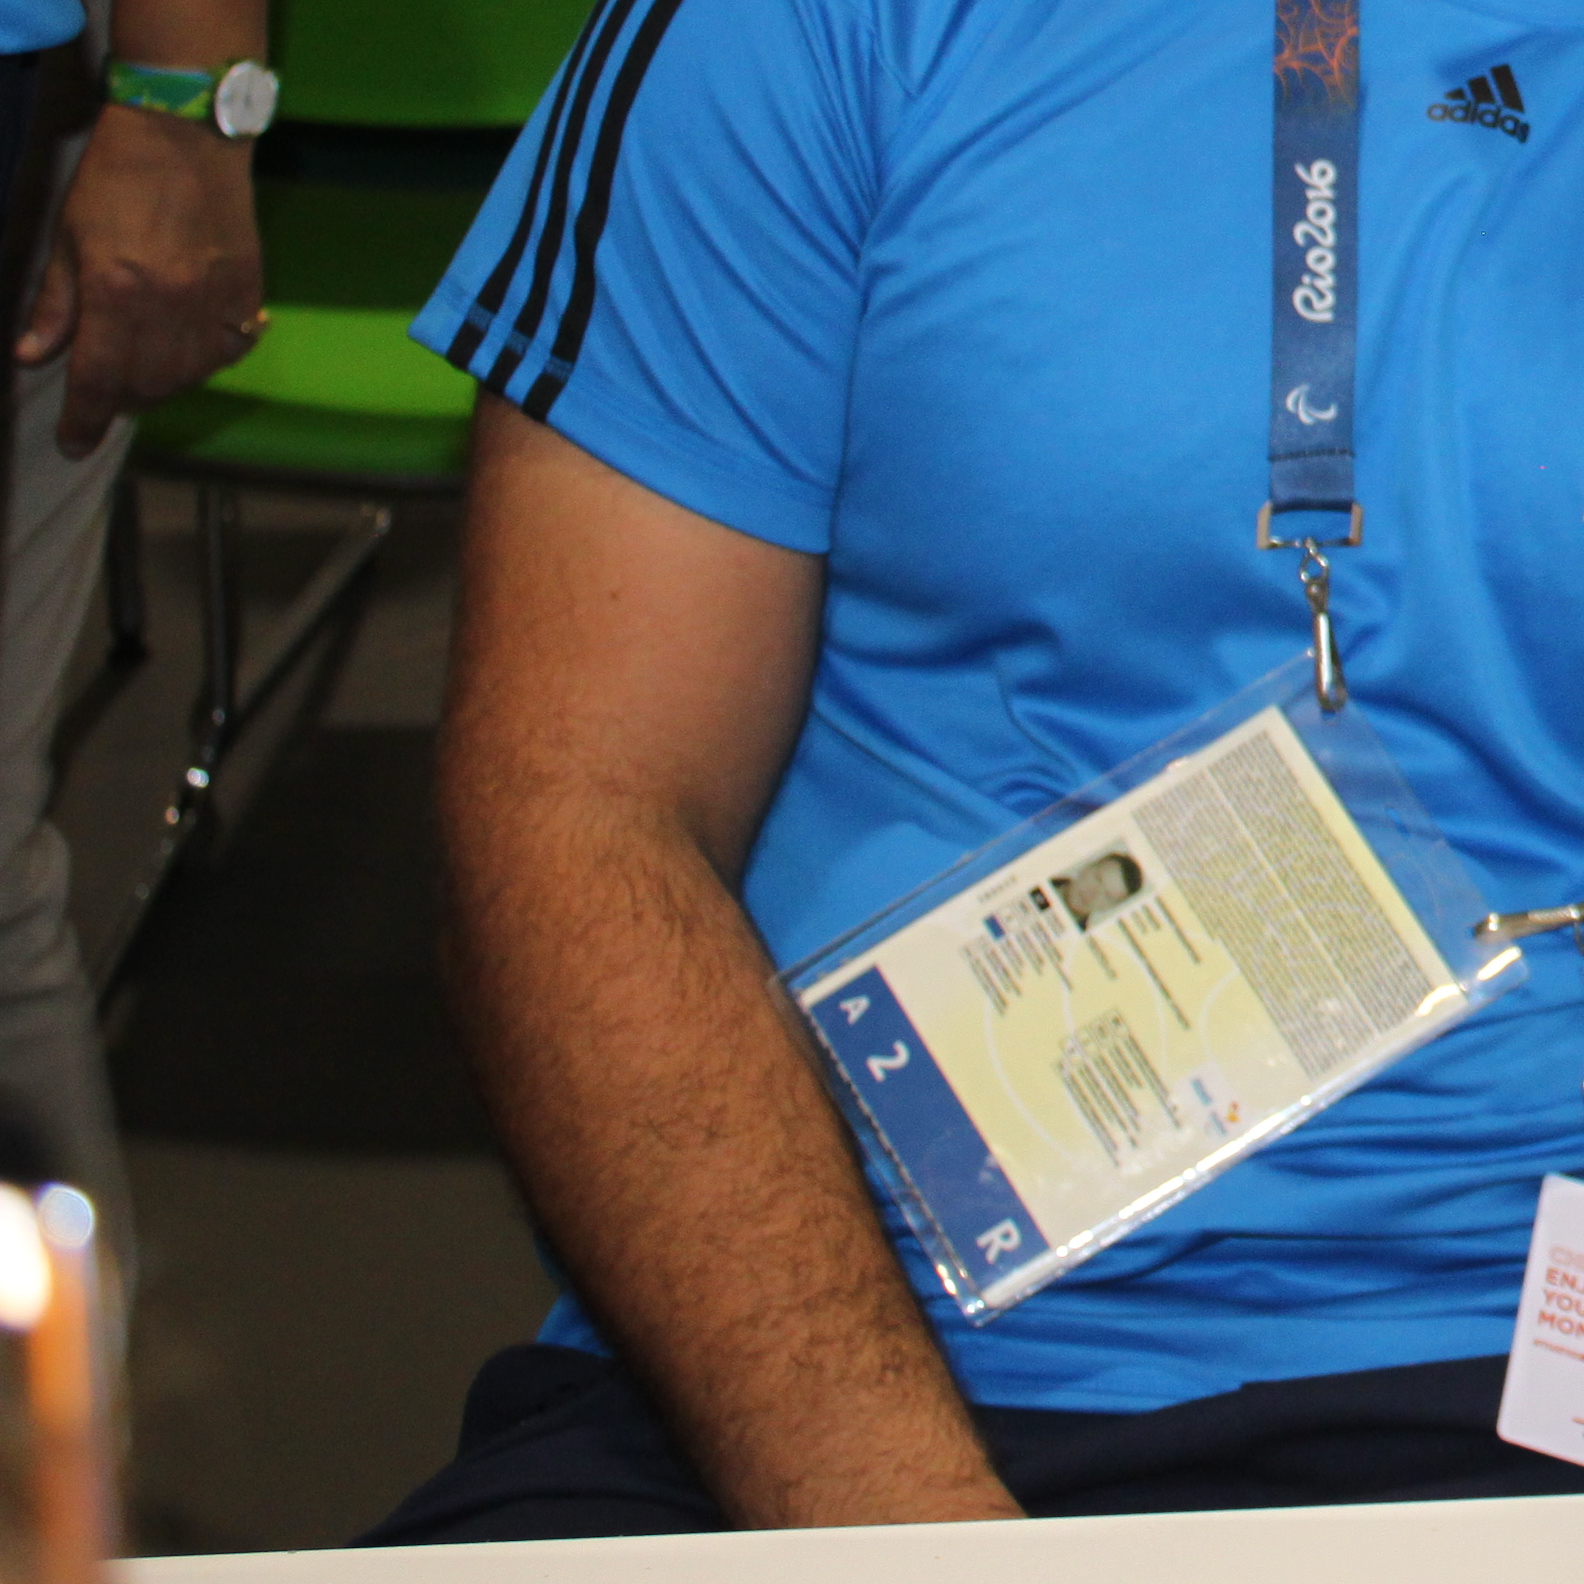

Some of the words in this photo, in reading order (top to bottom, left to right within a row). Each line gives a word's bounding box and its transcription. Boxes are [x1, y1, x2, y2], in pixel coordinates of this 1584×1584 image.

[838, 994, 871, 1026] A
[865, 1038, 911, 1084] 2
[975, 1218, 1023, 1265] R
